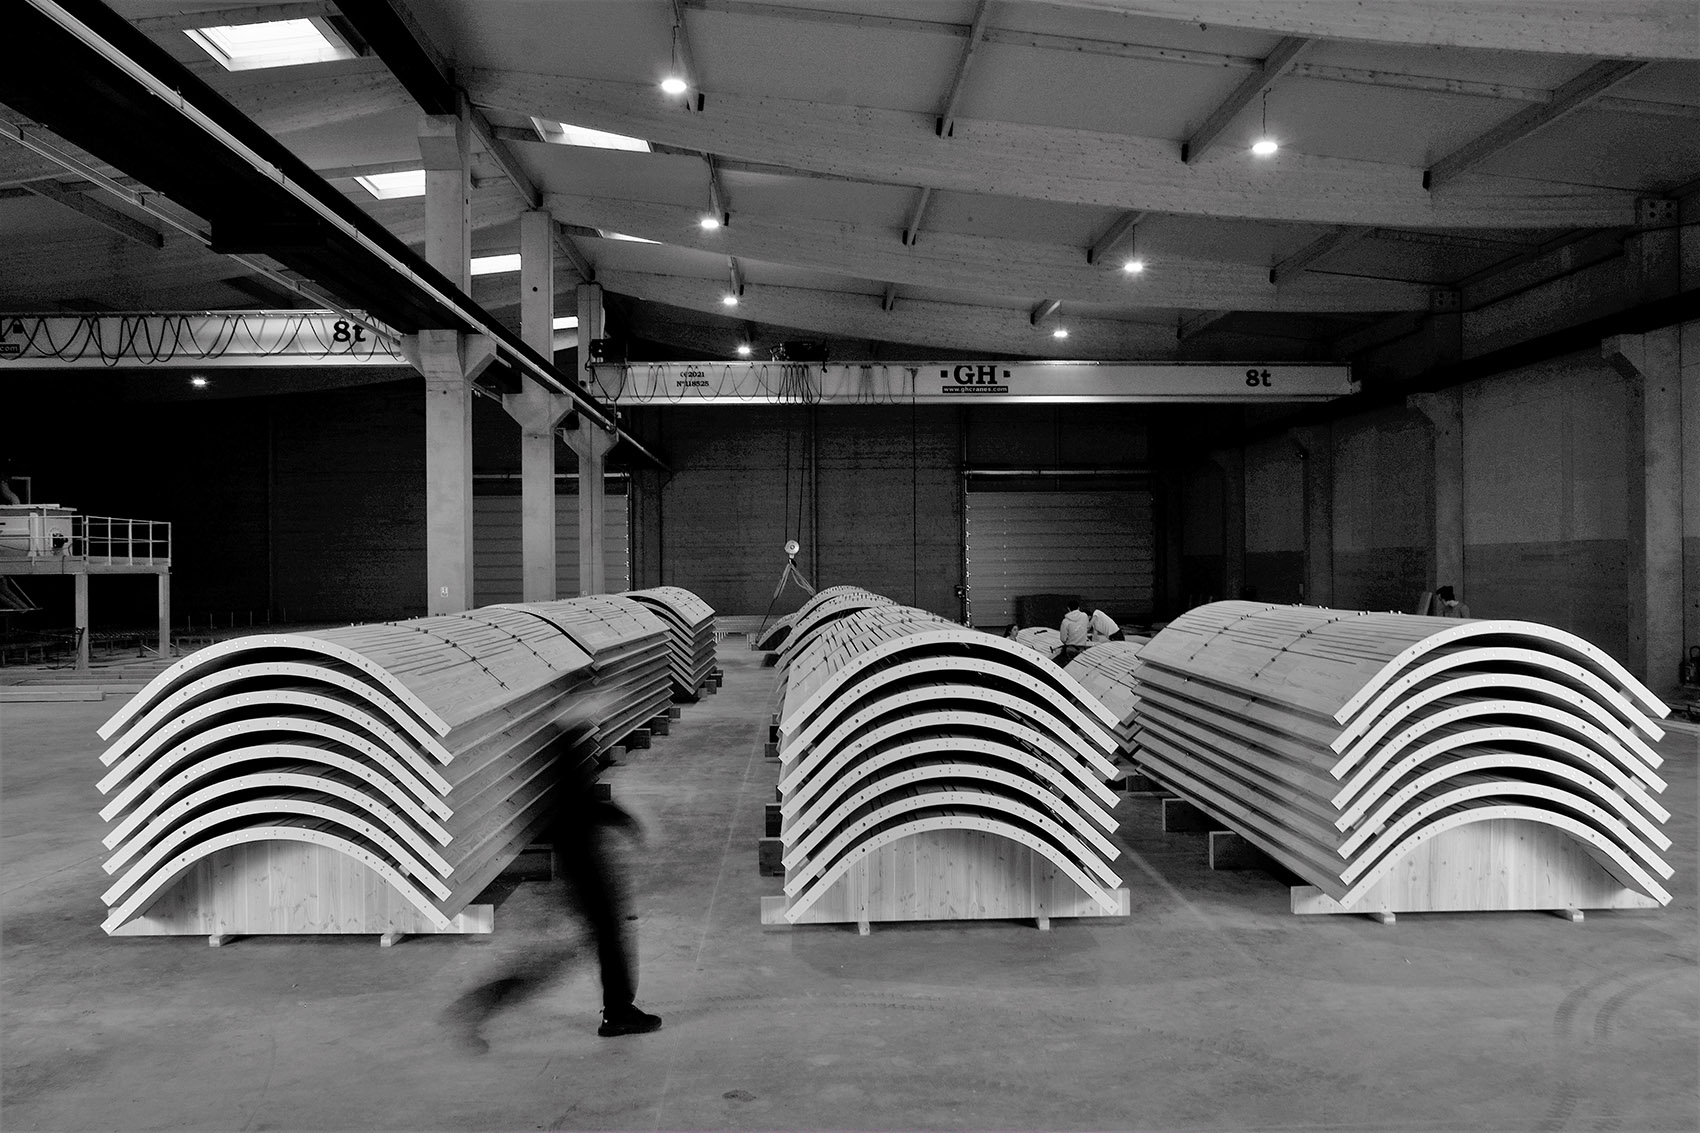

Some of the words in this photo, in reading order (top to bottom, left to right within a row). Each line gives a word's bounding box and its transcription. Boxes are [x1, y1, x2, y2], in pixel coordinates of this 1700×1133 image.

[333, 320, 366, 342] 8t
[953, 365, 997, 385] GH
[1245, 369, 1272, 387] 8t
